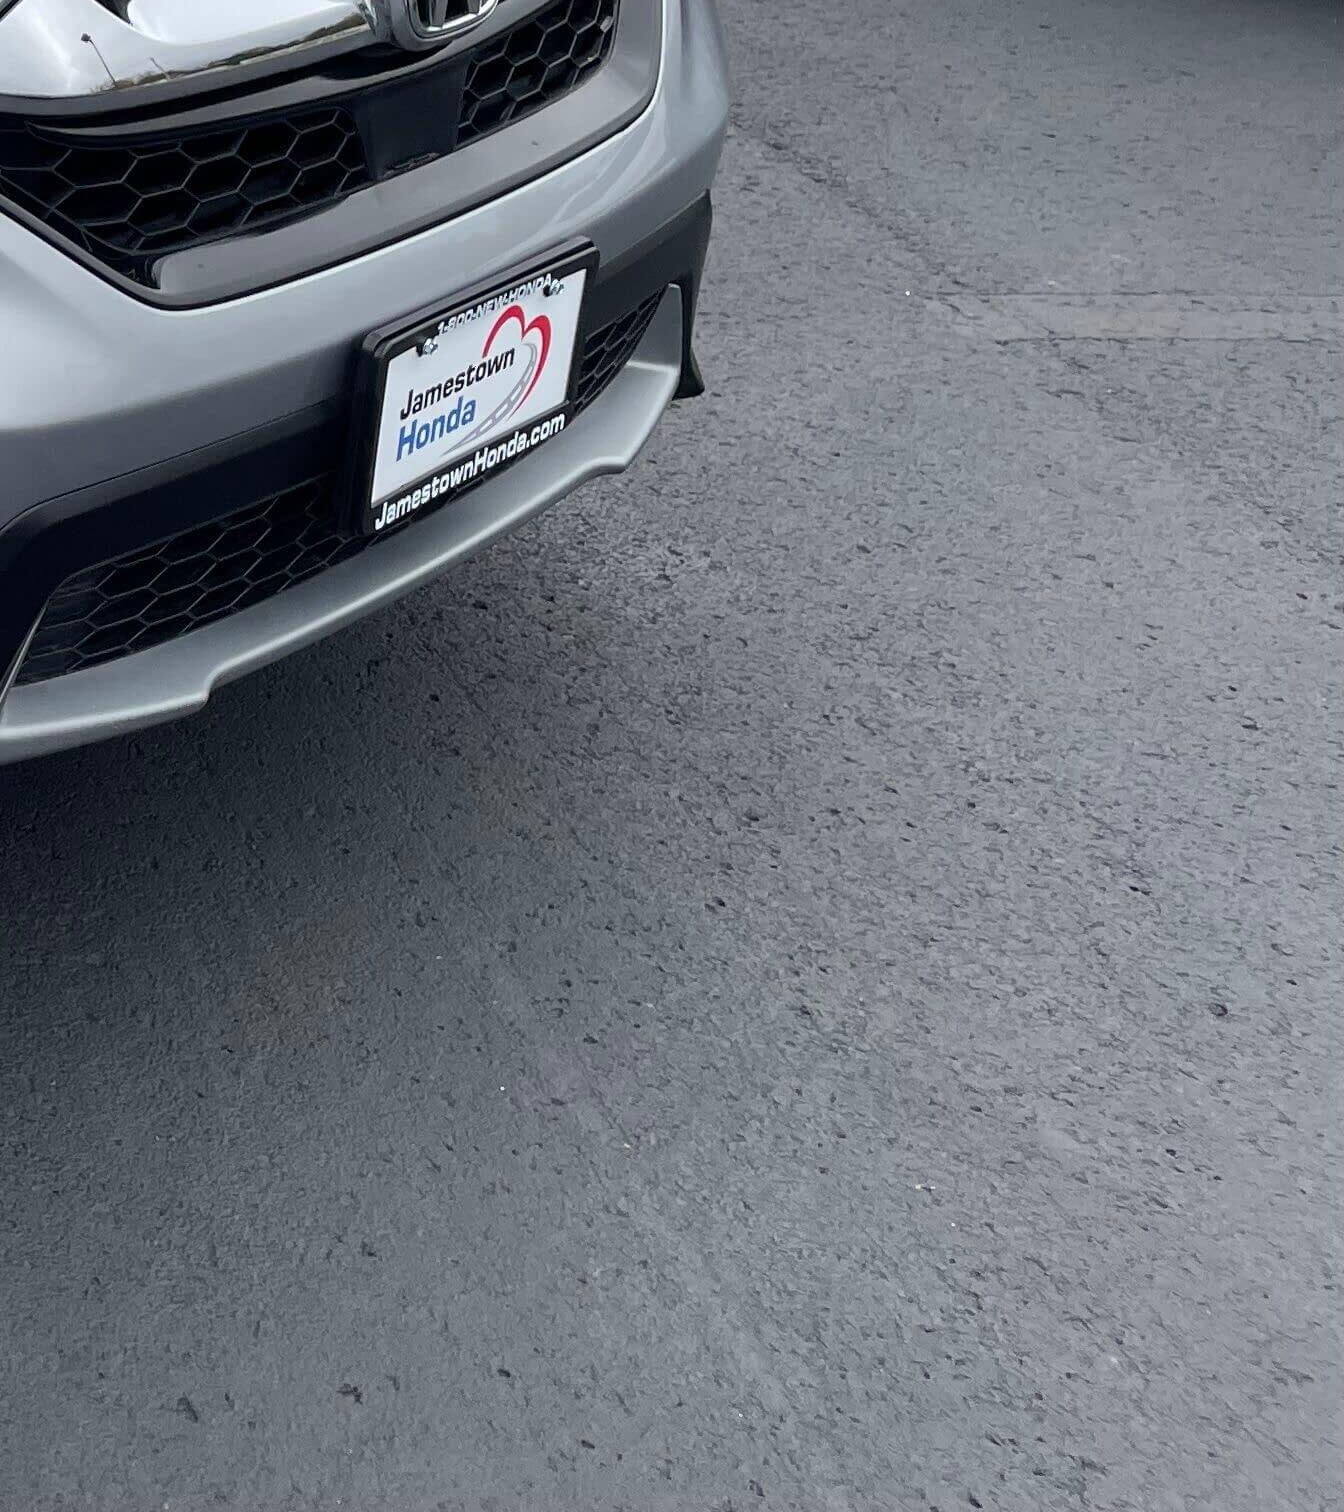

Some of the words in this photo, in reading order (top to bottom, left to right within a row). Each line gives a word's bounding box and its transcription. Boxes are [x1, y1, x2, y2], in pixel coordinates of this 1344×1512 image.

[437, 273, 551, 335] 1-800-NEW-HONDA
[400, 348, 515, 420] Jamestown
[396, 396, 477, 462] Honda
[375, 413, 565, 530] JamestownHonda.com
